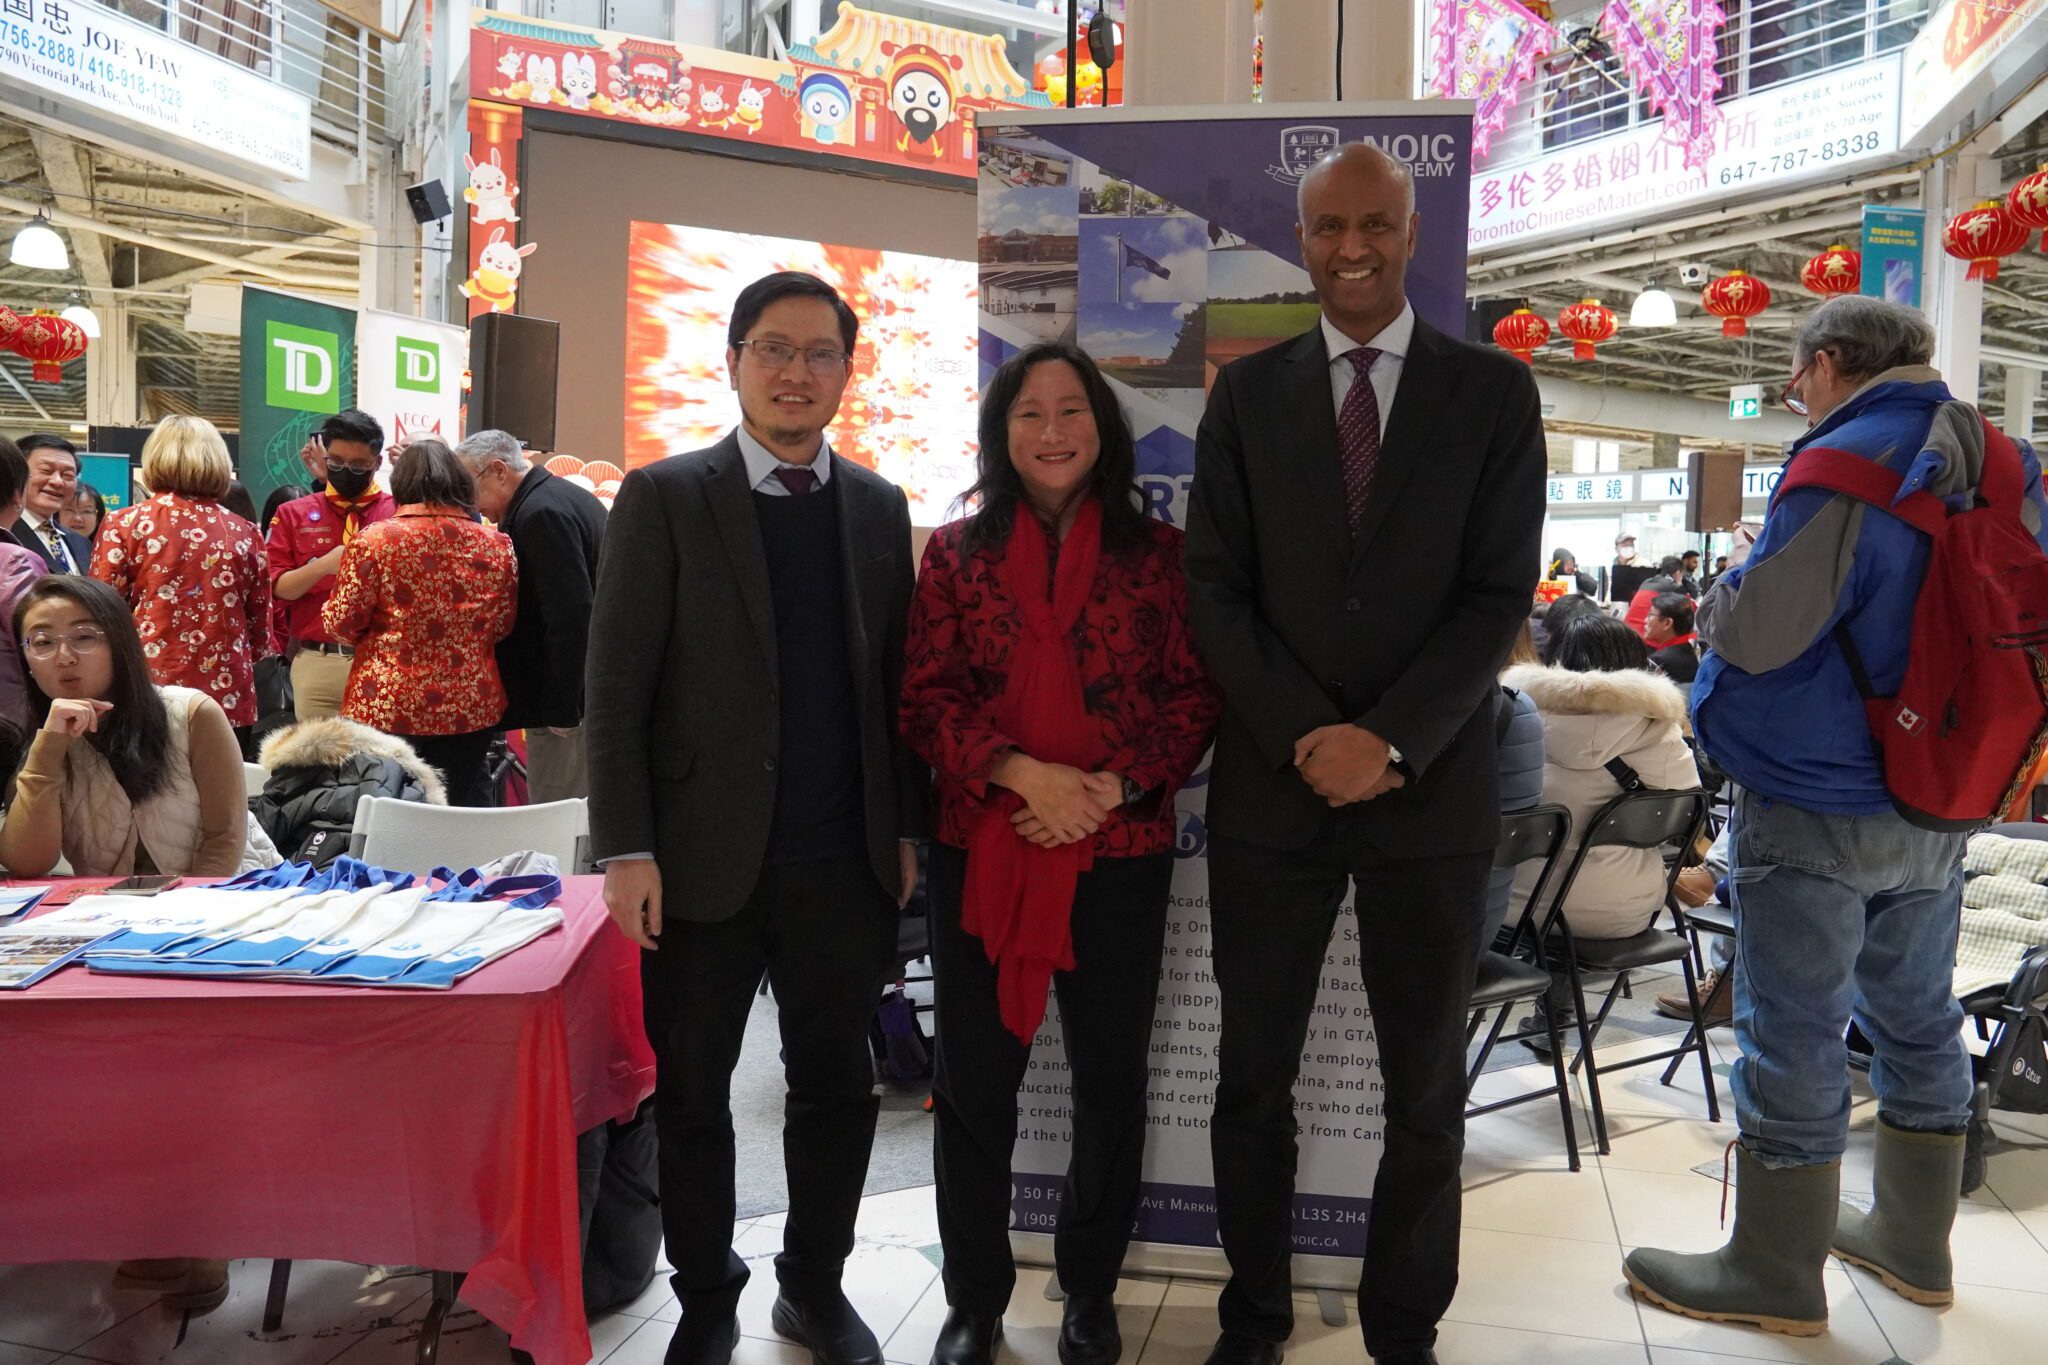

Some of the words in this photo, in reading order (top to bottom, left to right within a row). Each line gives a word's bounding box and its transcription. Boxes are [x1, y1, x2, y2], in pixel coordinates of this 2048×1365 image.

[0, 19, 75, 67] 756-2888
[88, 56, 182, 108] 416-918-1328
[82, 27, 127, 58] JOE
[135, 47, 182, 79] YEW
[22, 53, 69, 84] Victoria
[72, 73, 96, 95] Park
[1841, 72, 1884, 92] Largest
[1838, 92, 1884, 110] Success
[1859, 110, 1883, 126] Age
[1720, 130, 1880, 185] 647-787-8338
[273, 338, 332, 395] TD
[400, 346, 437, 383] TD
[1169, 968, 1190, 981] for
[1171, 992, 1219, 1010] (IBDP)
[1154, 1019, 1182, 1030] one
[1324, 1026, 1338, 1040] in
[1336, 1078, 1364, 1091] and
[1147, 1090, 1174, 1102] and
[1319, 1101, 1350, 1114] who
[1034, 1129, 1057, 1142] the
[1311, 1123, 1346, 1138] from
[1024, 1187, 1041, 1199] 50
[1302, 1208, 1330, 1222] L3S
[1335, 1210, 1367, 1224] 2H4
